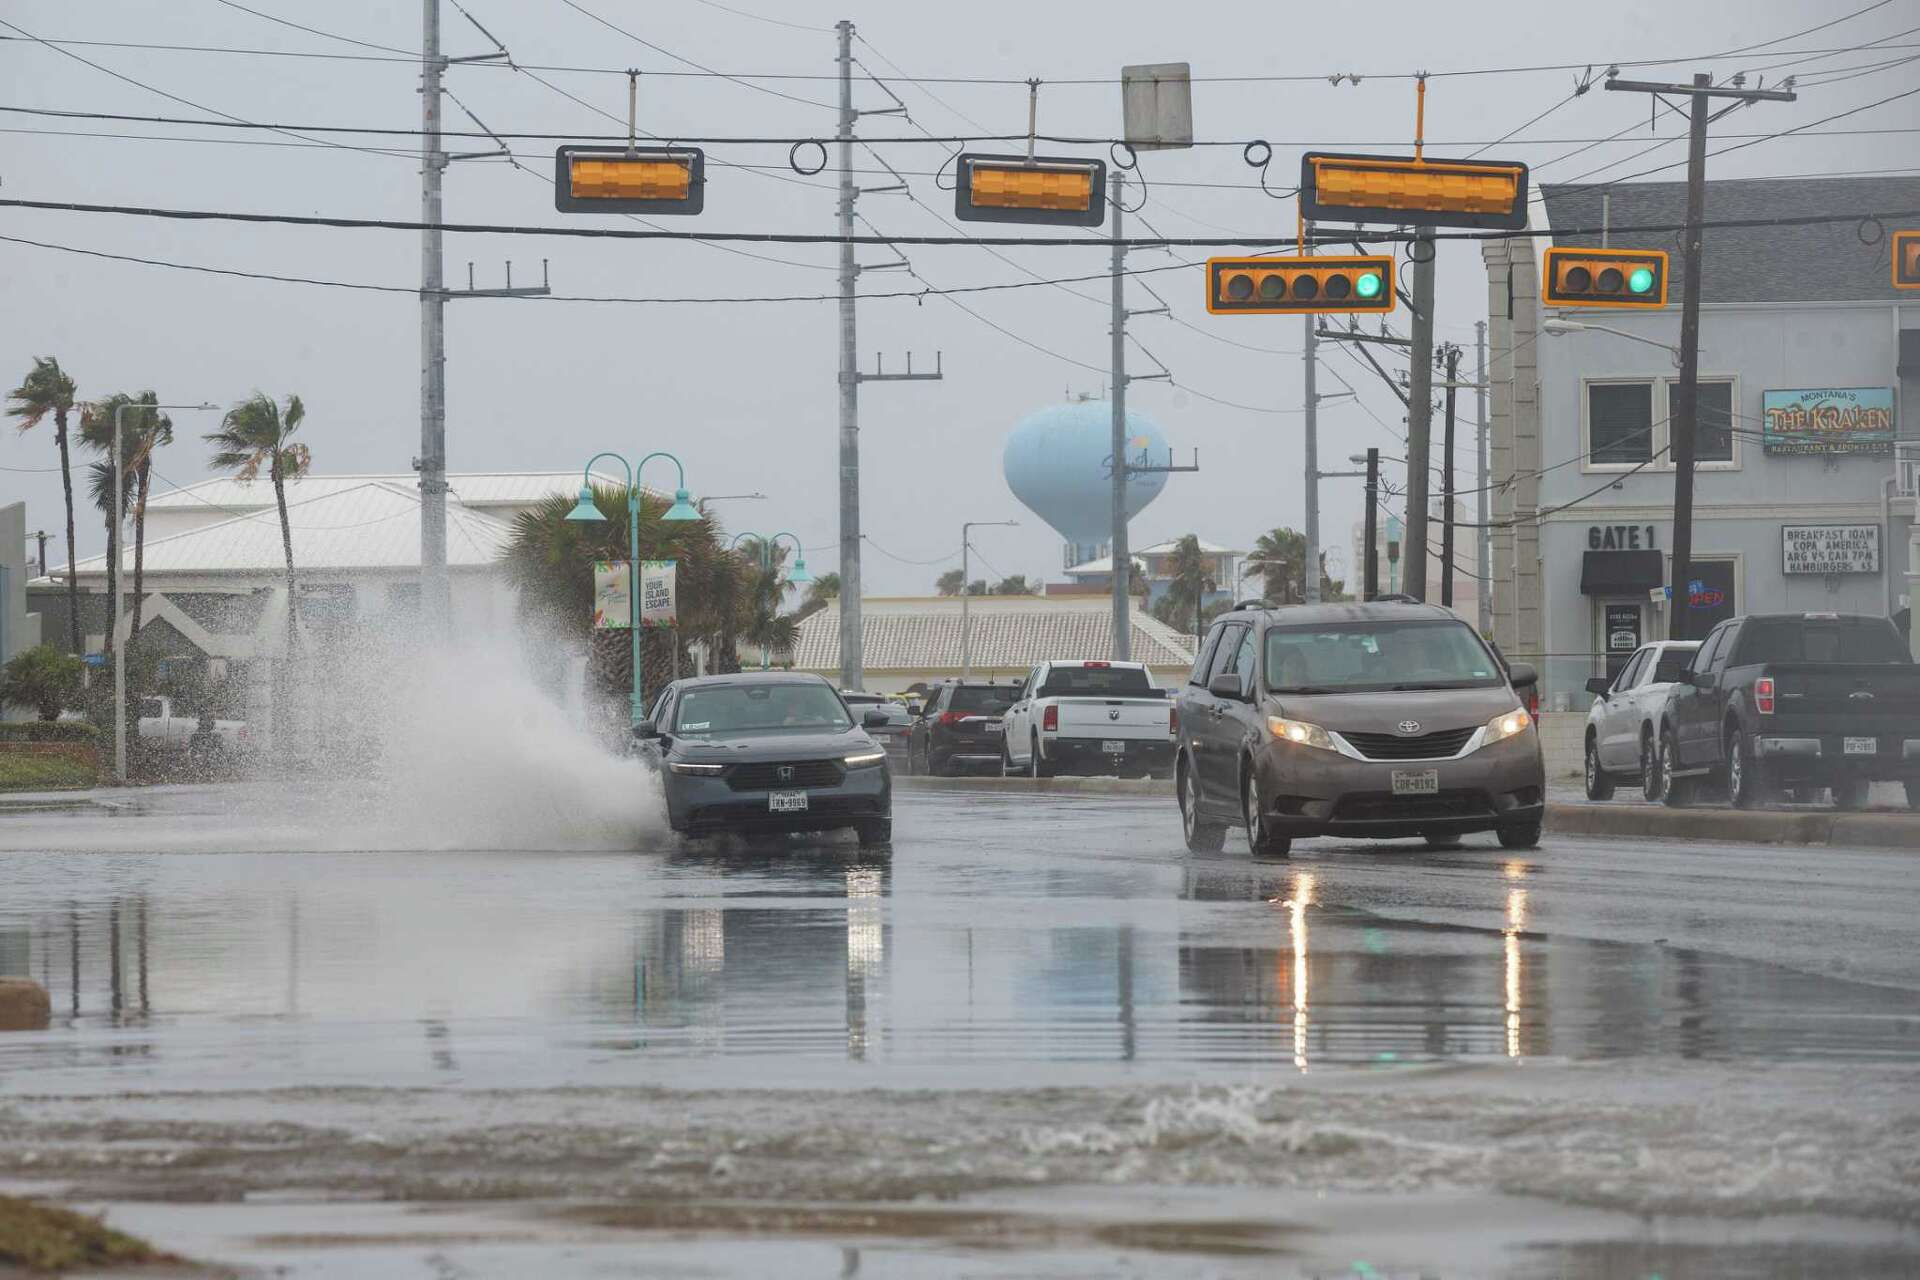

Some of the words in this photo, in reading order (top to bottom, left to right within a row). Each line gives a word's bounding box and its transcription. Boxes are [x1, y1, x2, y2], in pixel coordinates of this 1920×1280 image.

[1801, 390, 1856, 402] MONTANA'S
[1767, 405, 1806, 431] THE
[1811, 404, 1890, 431] KRAKEN
[1589, 526, 1640, 549] GATE
[1645, 525, 1654, 549] 1
[1787, 529, 1845, 540] BREAKFAST
[1848, 529, 1874, 539] 10AM
[1793, 541, 1817, 550] COPA
[1826, 541, 1869, 550] AMERICA
[1787, 552, 1808, 561] ARG
[1812, 551, 1825, 560] VS
[1828, 551, 1848, 560] CAN
[1852, 551, 1873, 560] 7PM
[1790, 562, 1853, 571] HAMBURGERS
[645, 581, 663, 590] YOUR
[645, 588, 669, 599] ISLAND
[645, 597, 670, 609] ESCAPE
